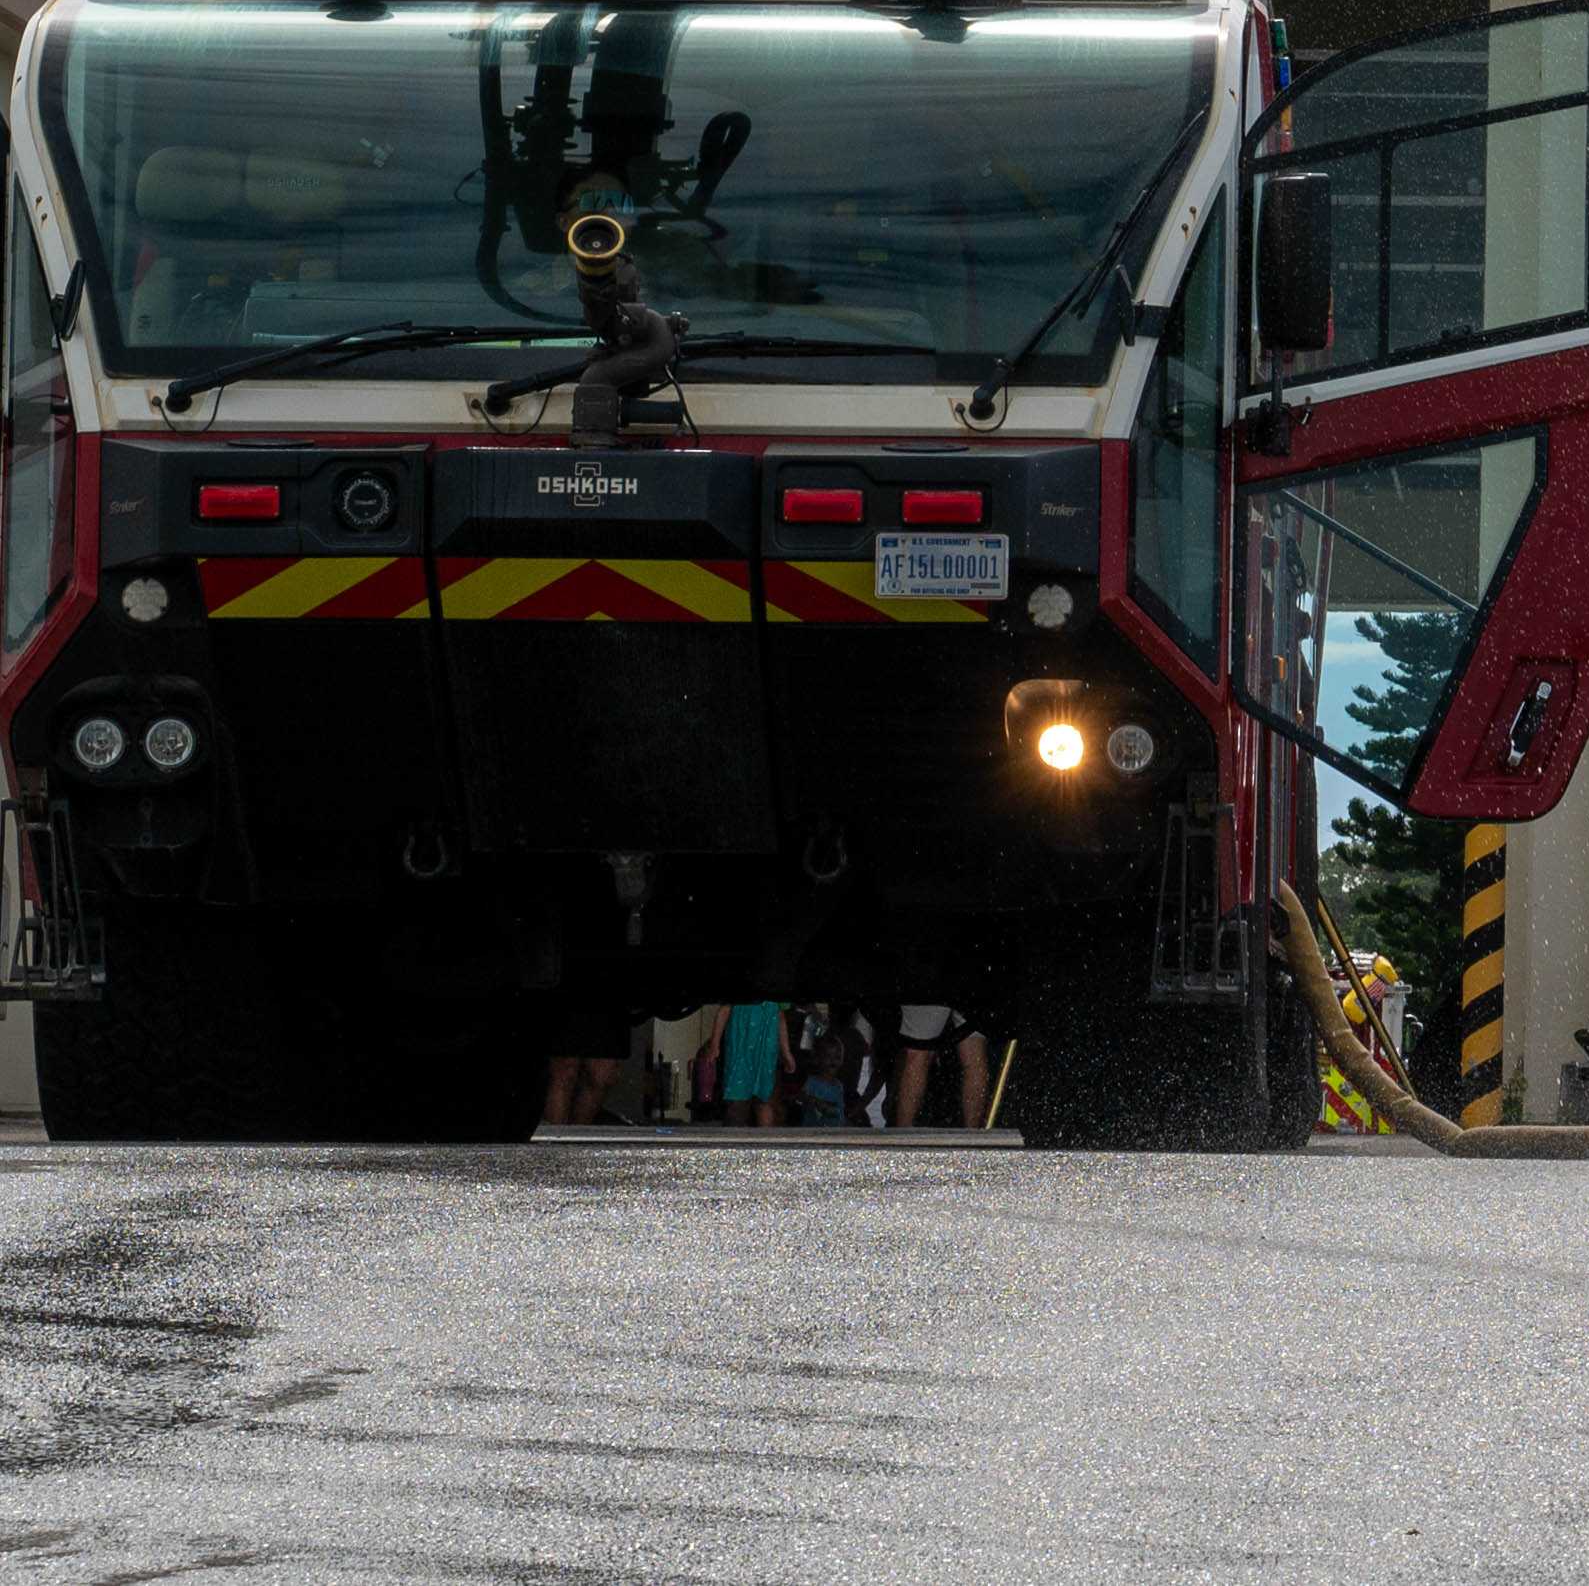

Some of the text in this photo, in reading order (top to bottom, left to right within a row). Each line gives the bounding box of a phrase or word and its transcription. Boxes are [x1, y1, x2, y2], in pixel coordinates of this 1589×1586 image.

[537, 476, 638, 495] OSHKOSH
[1040, 502, 1078, 517] Striker
[881, 553, 999, 579] AF15L00001
